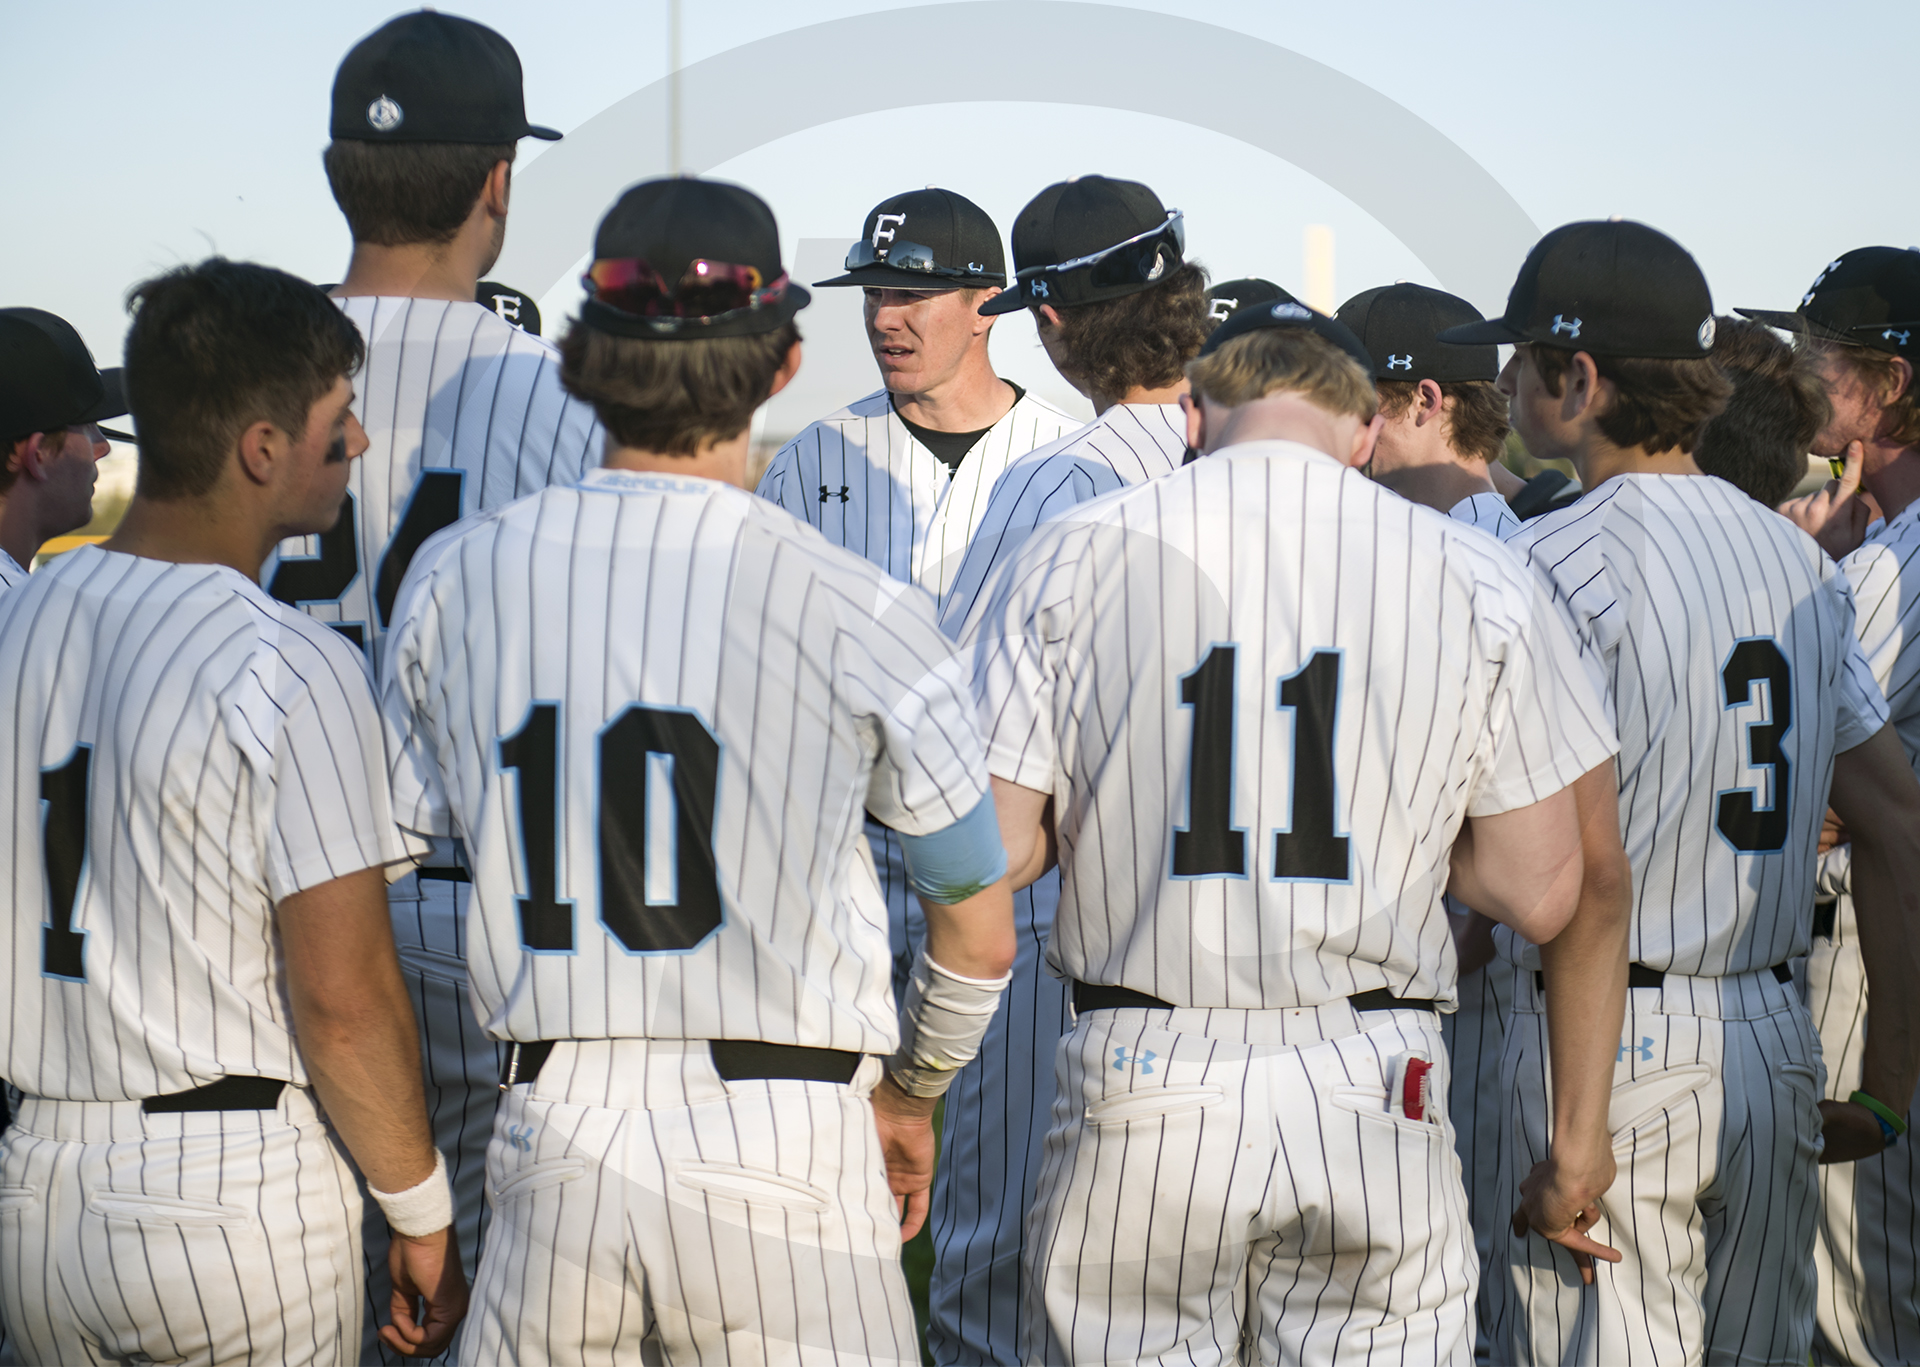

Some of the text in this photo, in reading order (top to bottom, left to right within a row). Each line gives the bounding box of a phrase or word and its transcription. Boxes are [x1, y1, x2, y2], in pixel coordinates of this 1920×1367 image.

[595, 474, 708, 494] ARMOUR
[40, 740, 93, 984] 1
[496, 698, 727, 957] 10
[1171, 640, 1353, 884] 11
[1717, 635, 1793, 856] 3
